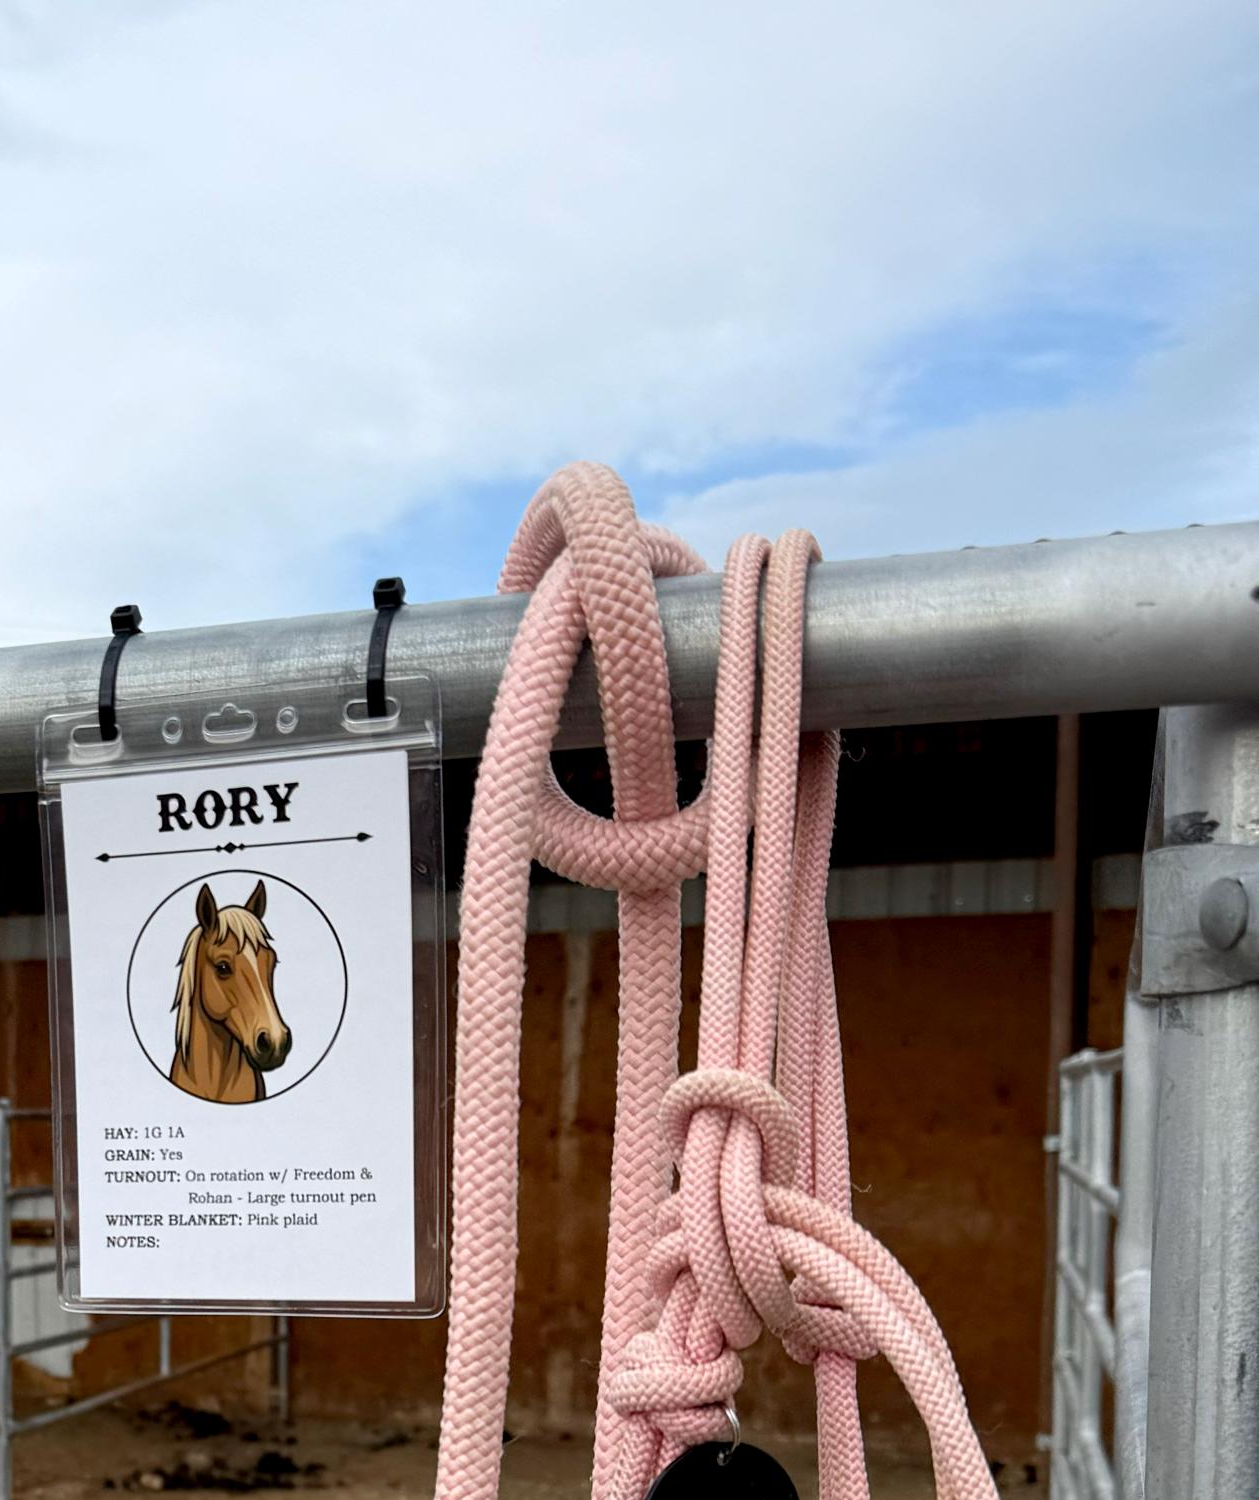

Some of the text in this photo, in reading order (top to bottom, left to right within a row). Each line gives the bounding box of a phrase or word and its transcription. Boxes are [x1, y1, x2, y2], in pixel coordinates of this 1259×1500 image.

[156, 781, 300, 833] RORY
[103, 1125, 186, 1141] HAY: 1G 1A
[104, 1148, 184, 1162] GRAIN: Yes
[103, 1166, 374, 1185] TURNOUT: On rotation w/ Freedom &
[188, 1191, 233, 1205] Rohan
[247, 1191, 286, 1207] Large
[289, 1191, 346, 1204] turnout
[349, 1192, 377, 1207] pen
[104, 1212, 319, 1229] WINTER BLANKET: Pink plaid
[105, 1235, 161, 1249] NOTES:
